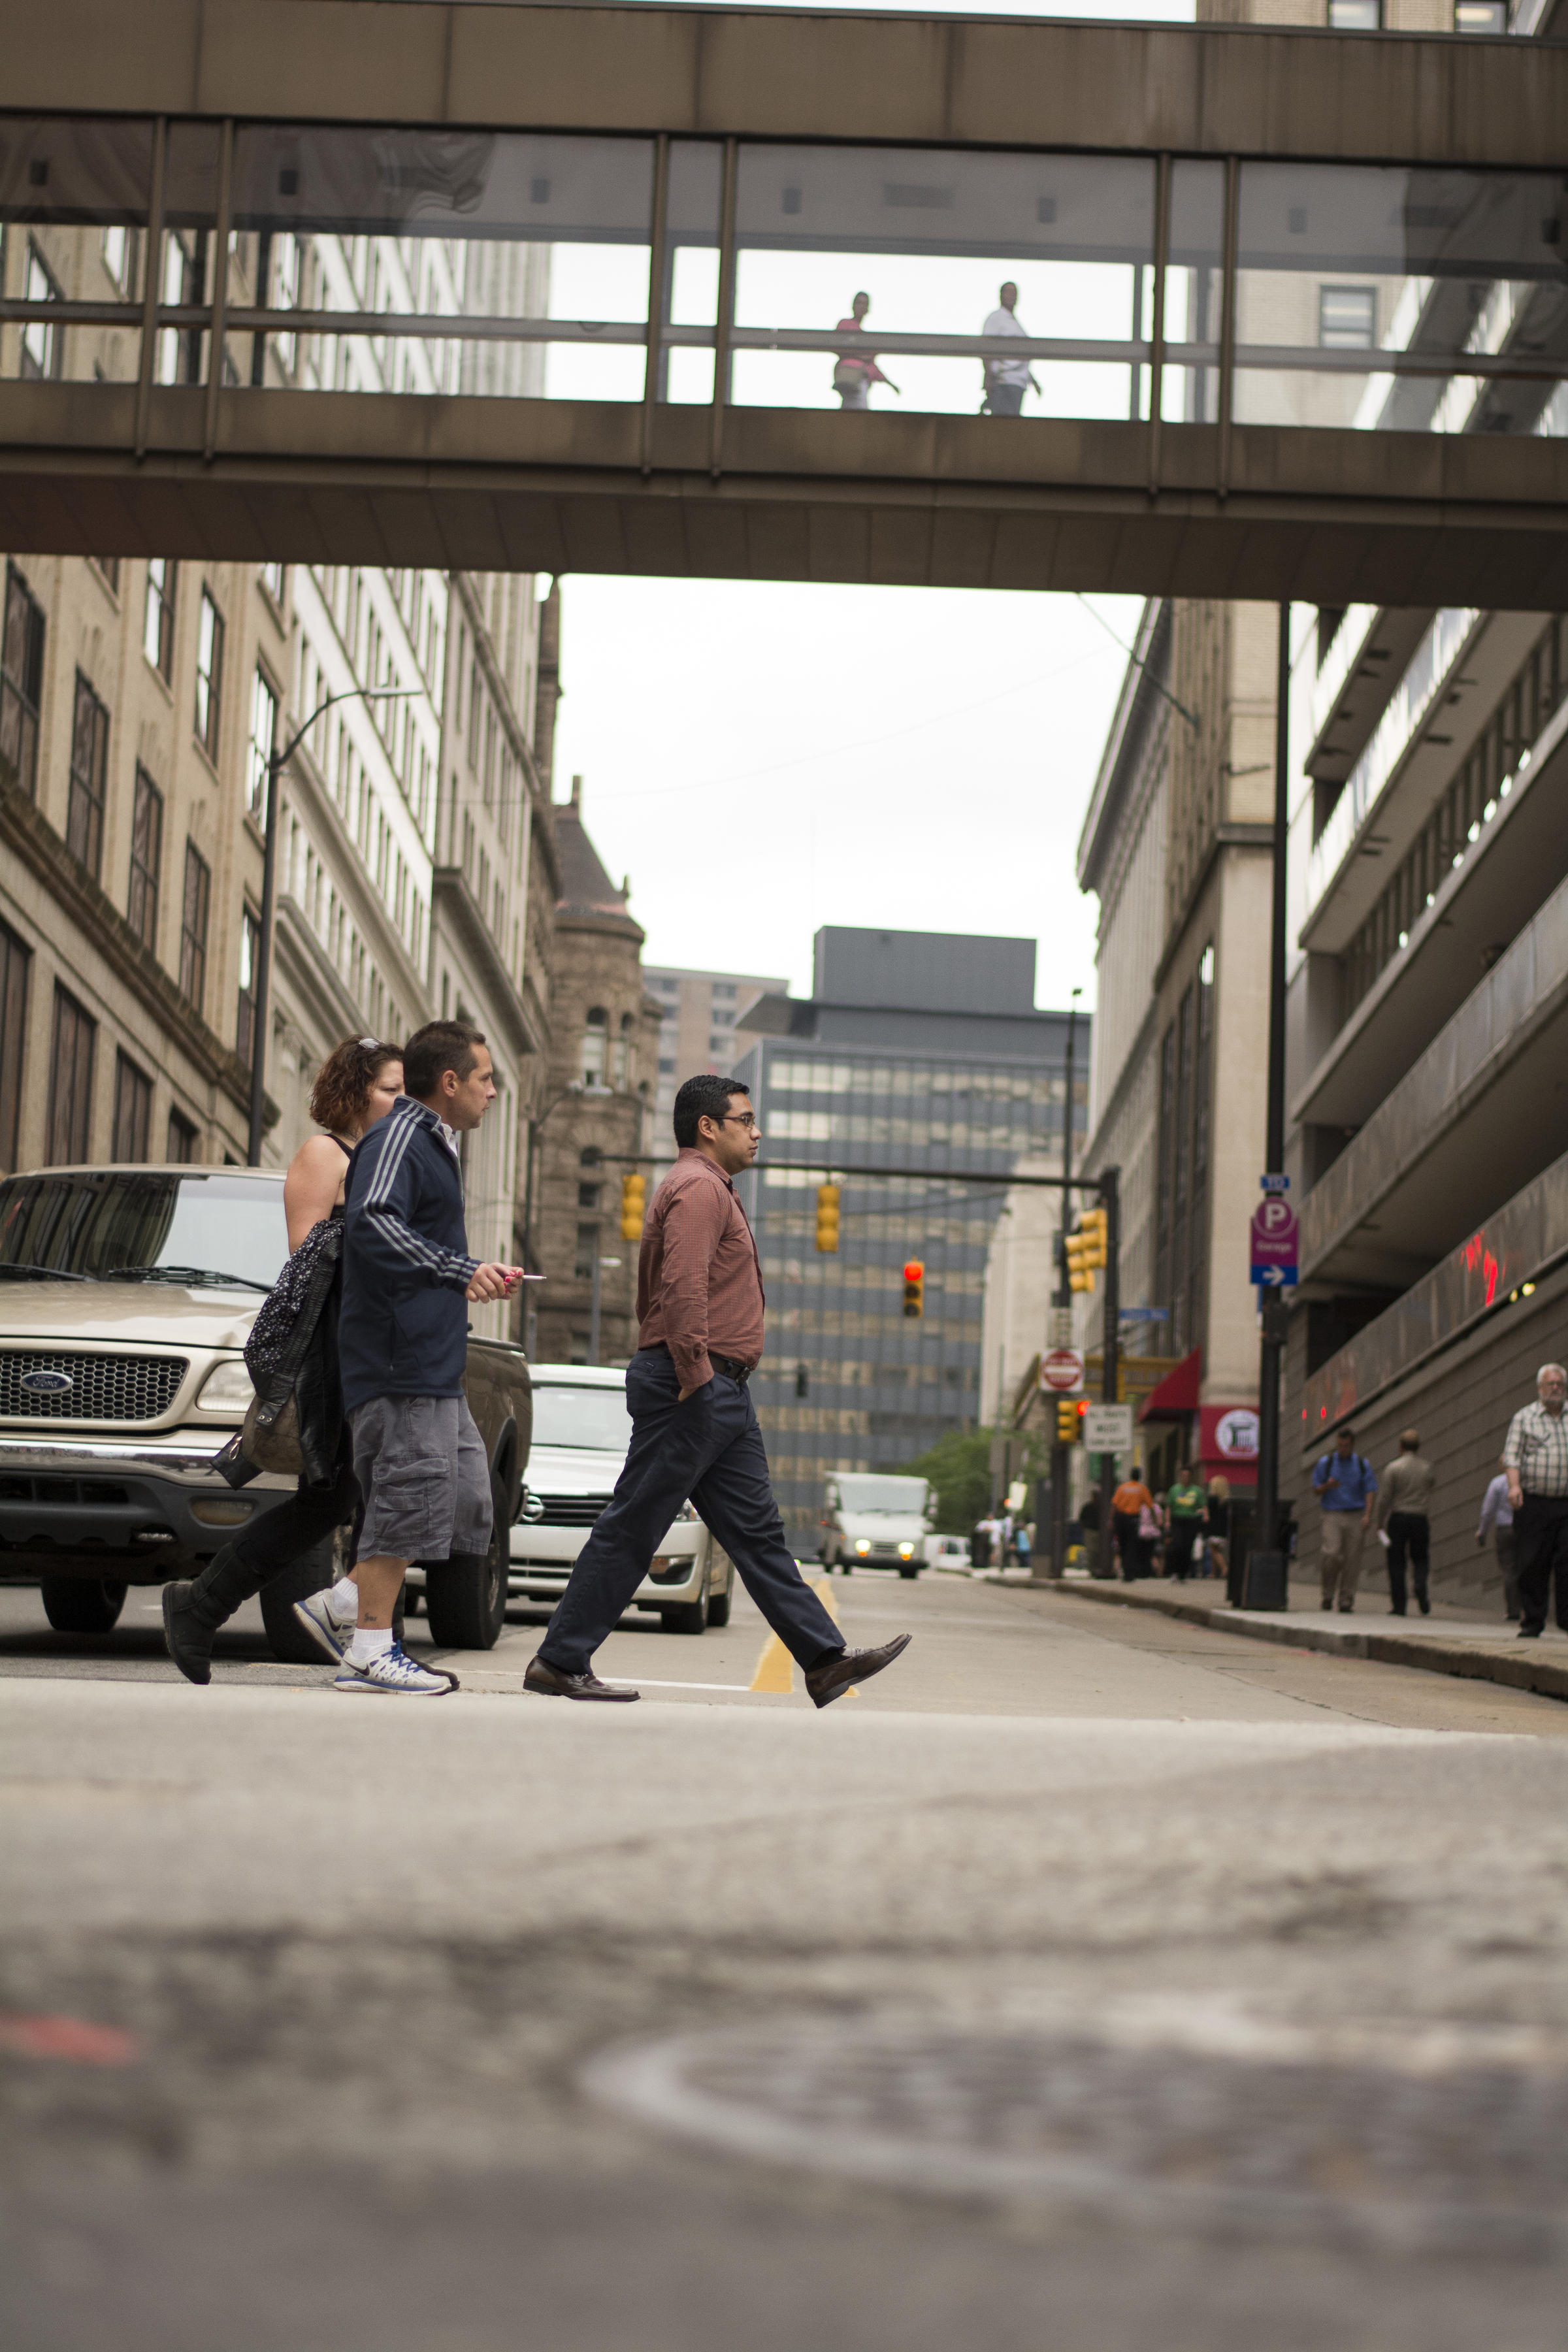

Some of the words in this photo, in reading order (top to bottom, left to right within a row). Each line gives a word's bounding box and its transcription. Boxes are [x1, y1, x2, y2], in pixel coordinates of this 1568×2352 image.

[1265, 1203, 1287, 1230] P
[1256, 1241, 1292, 1253] Garage
[33, 1375, 59, 1388] Ford
